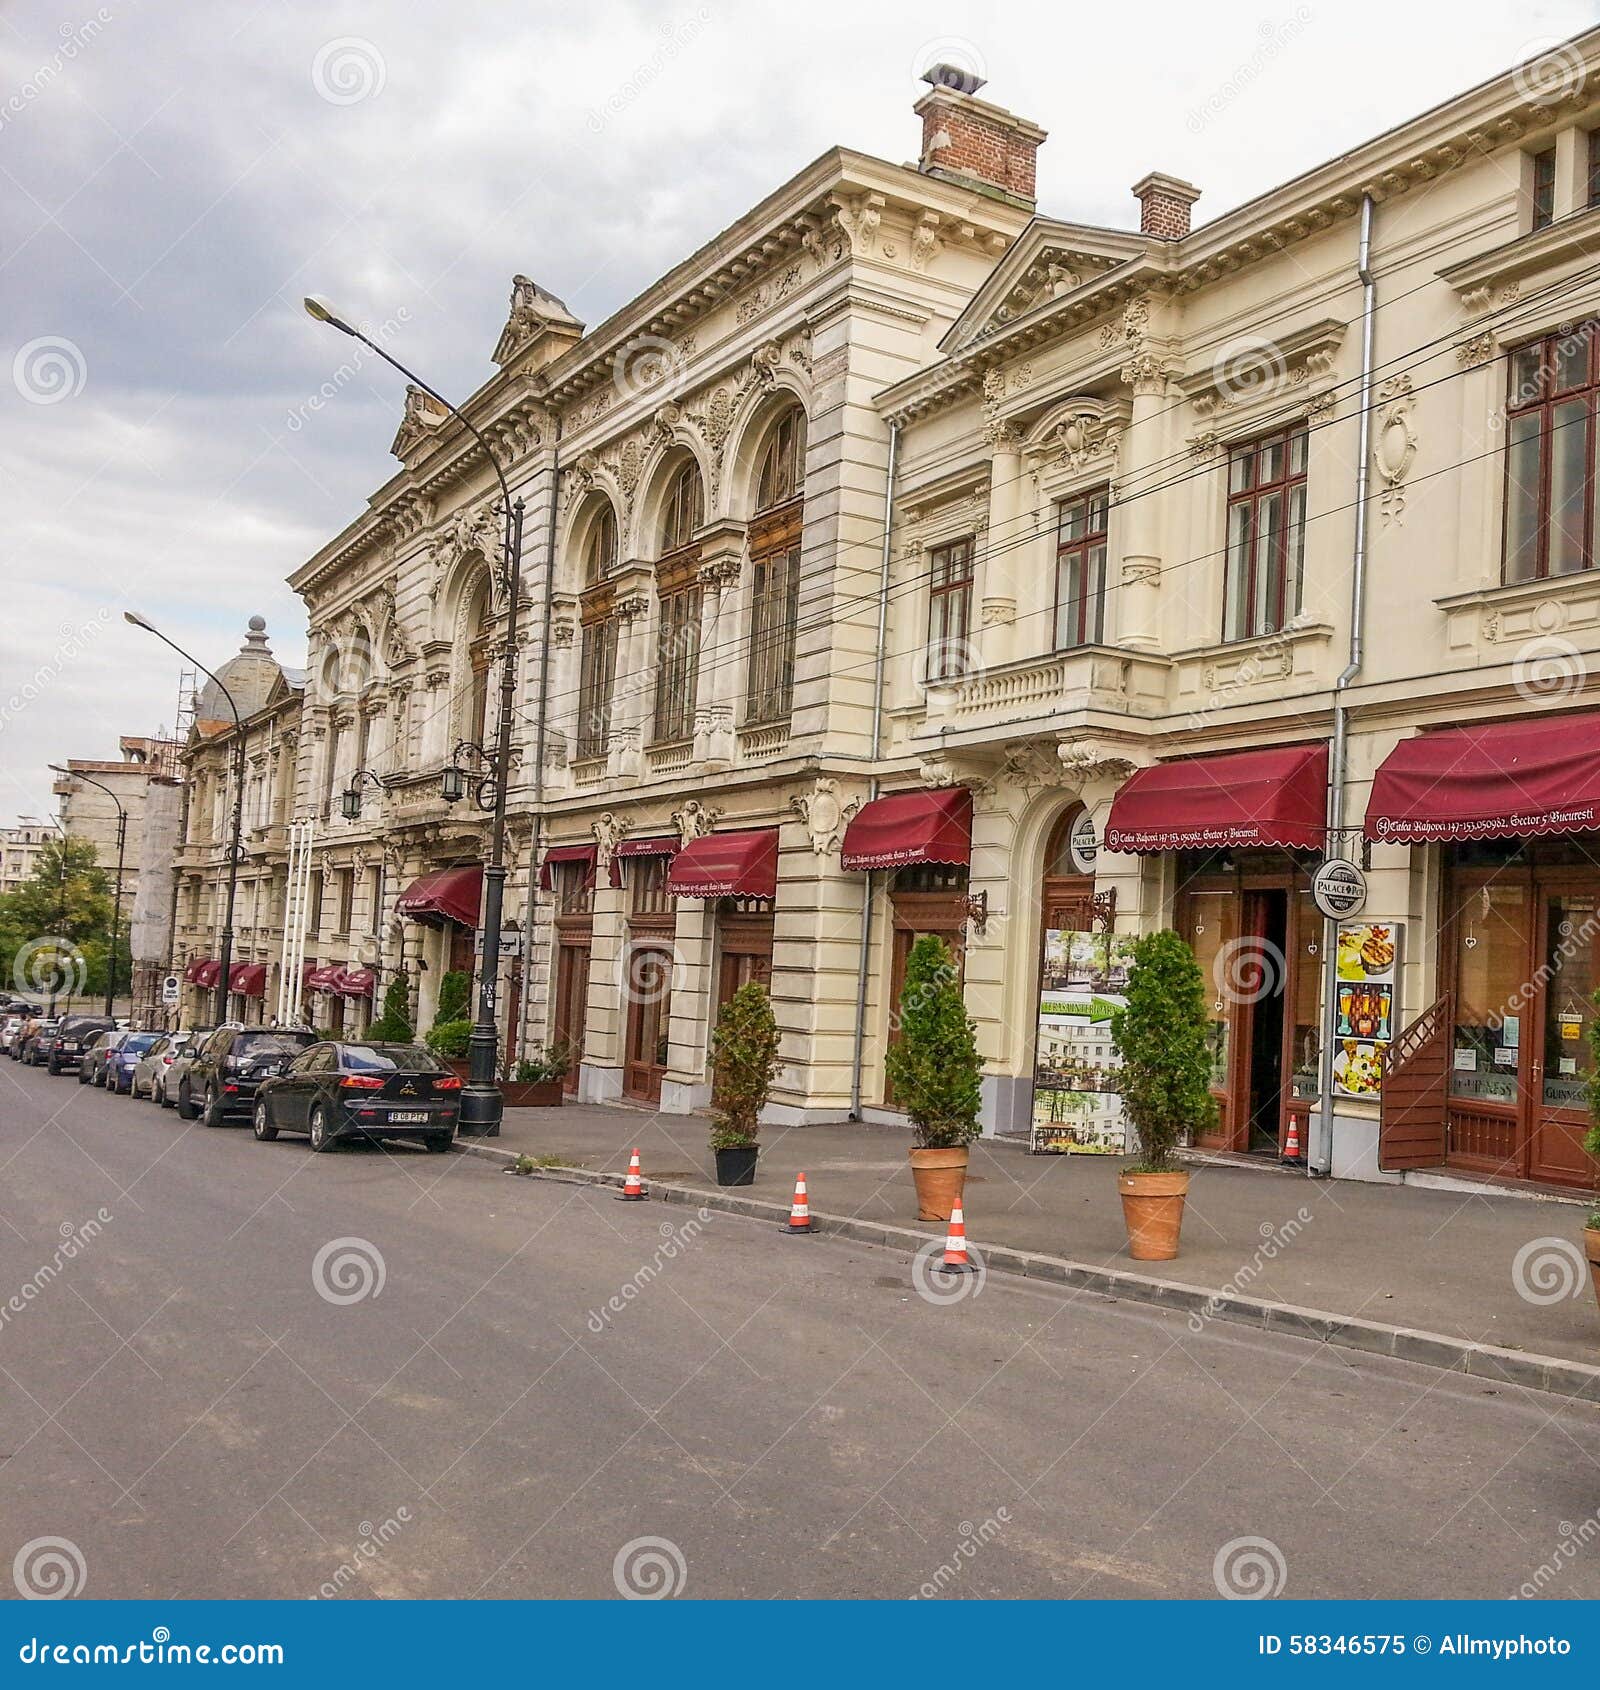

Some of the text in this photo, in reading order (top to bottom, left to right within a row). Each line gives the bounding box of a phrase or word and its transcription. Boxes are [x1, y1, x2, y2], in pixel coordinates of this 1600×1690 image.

[1510, 812, 1540, 827] Sector
[1540, 814, 1548, 827] 5
[1203, 828, 1223, 840] Sector
[1317, 880, 1346, 894] PALACE
